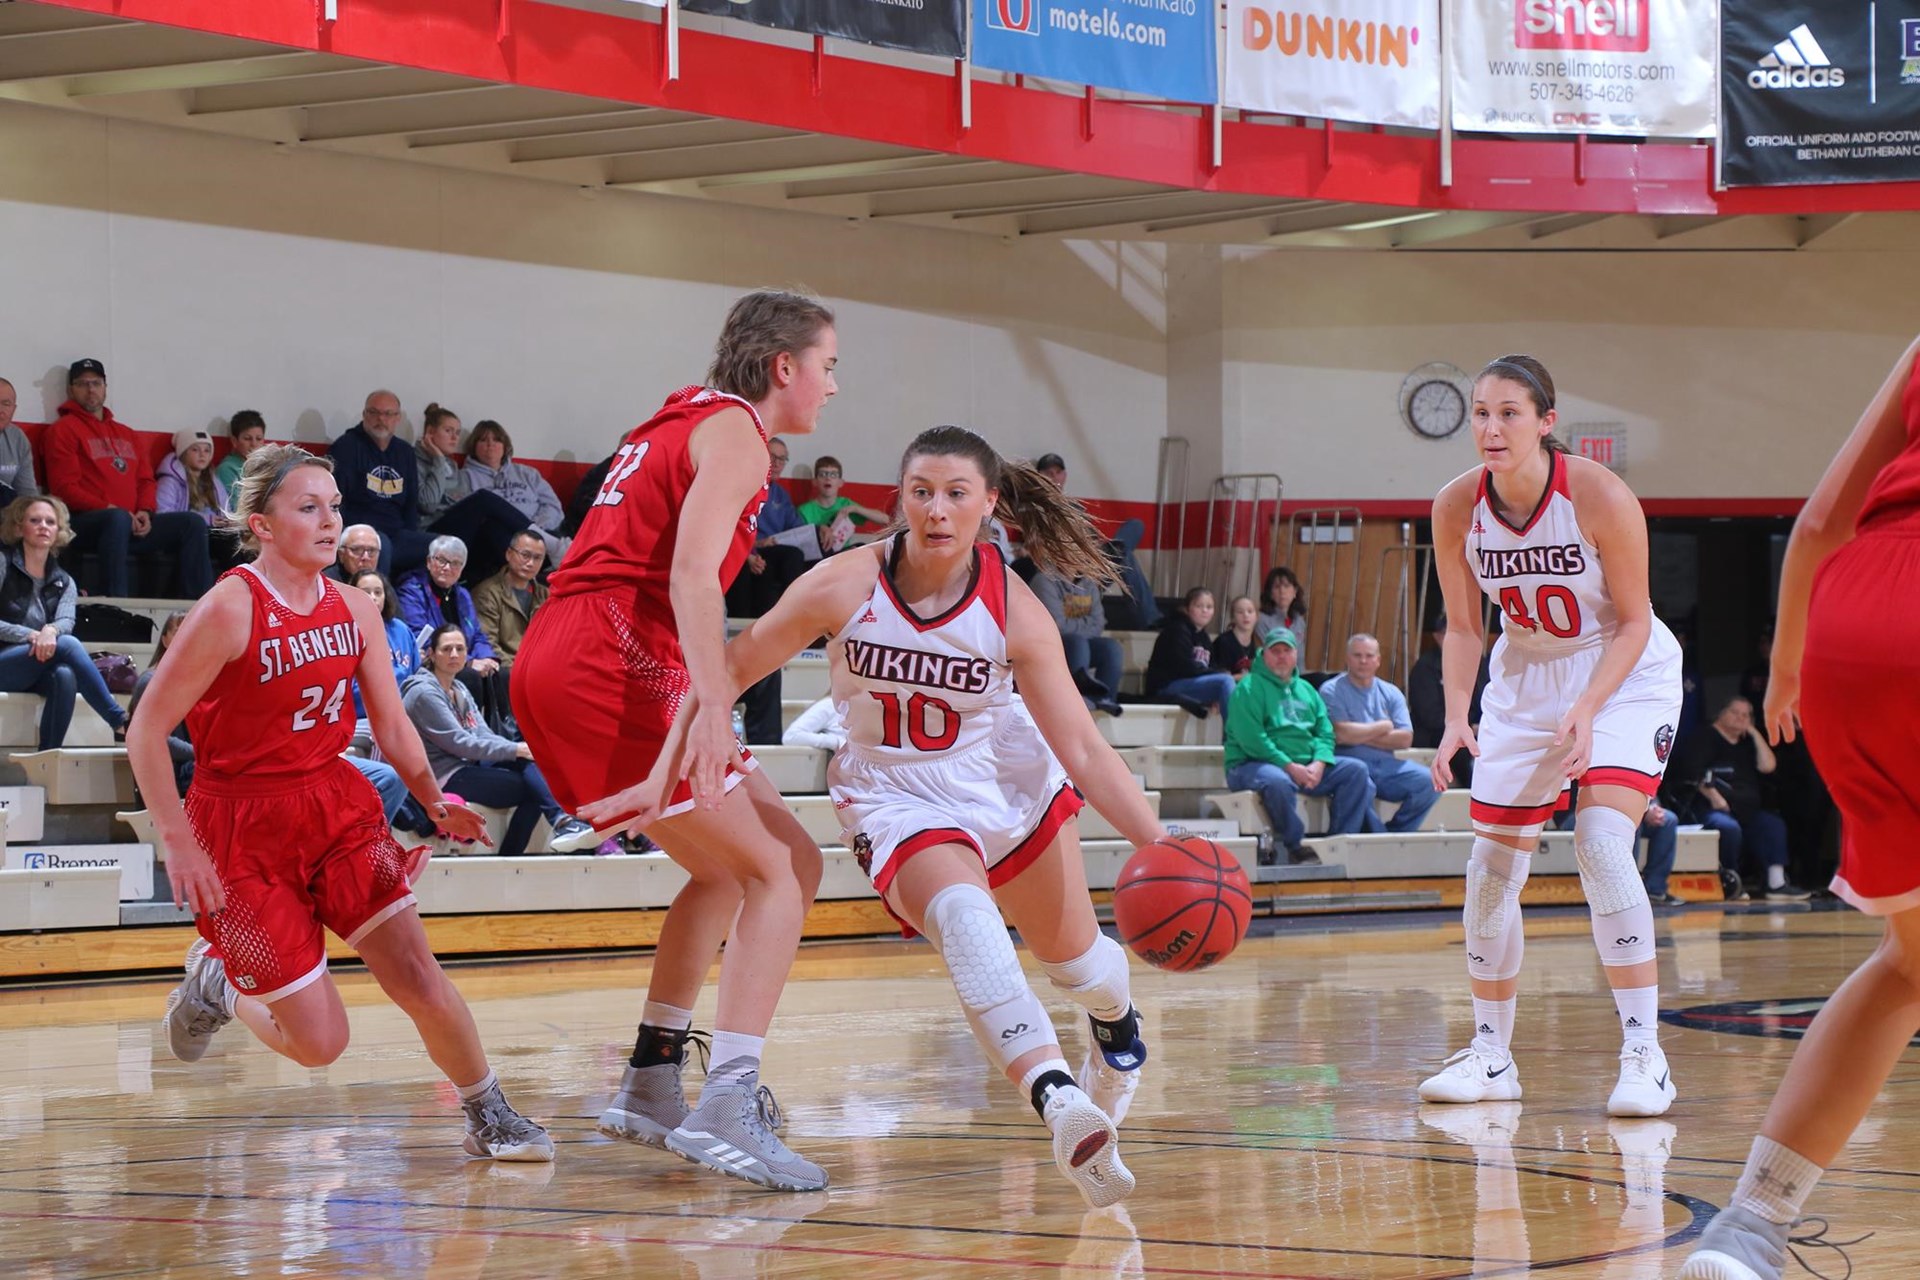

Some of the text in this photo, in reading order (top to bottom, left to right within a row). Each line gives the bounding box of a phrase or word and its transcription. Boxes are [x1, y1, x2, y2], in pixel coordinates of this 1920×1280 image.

[1049, 7, 1167, 47] motel6.com
[1523, 0, 1638, 37] snell
[1488, 59, 1676, 80] www.snellmotors.com
[1746, 65, 1846, 89] adidas
[1529, 83, 1635, 103] 507-345-4626
[1500, 112, 1536, 124] BUICK
[1746, 135, 1797, 147] OFFICIAL
[1798, 133, 1850, 146] UNIFORM
[1851, 132, 1877, 143] AND
[1797, 148, 1851, 160] BETHANY
[1852, 146, 1912, 158] LUTHERAN
[592, 440, 649, 507] 22
[1477, 544, 1585, 579] VIKINGS
[1499, 584, 1582, 639] 40
[845, 638, 993, 694] VIKINGS
[292, 677, 348, 732] 24
[868, 690, 962, 752] 10
